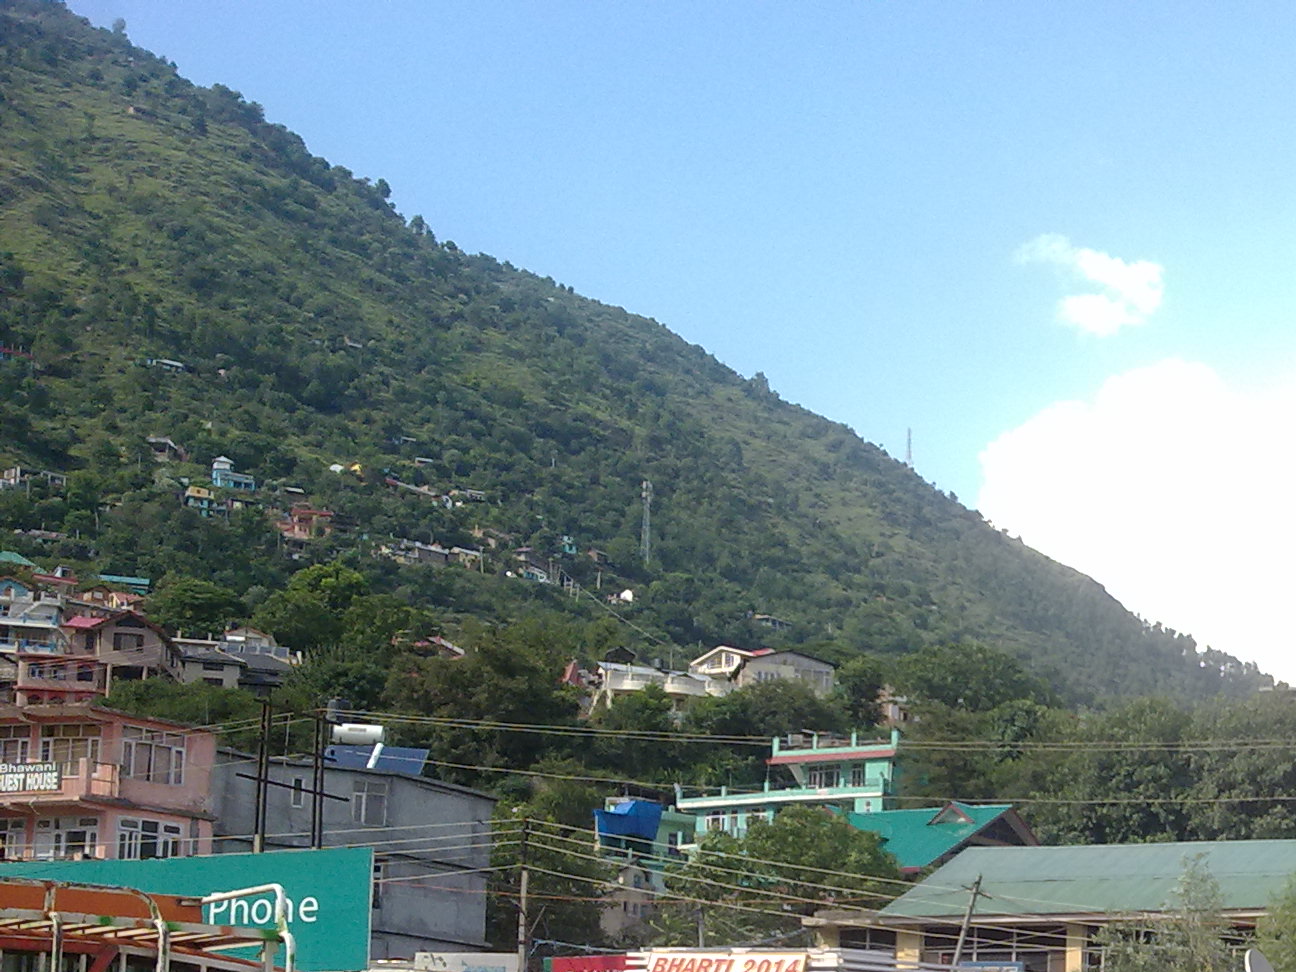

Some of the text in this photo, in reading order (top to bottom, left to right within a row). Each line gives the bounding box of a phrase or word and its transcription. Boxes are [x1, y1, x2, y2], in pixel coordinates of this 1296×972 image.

[0, 772, 58, 791] UEST HOUSE
[208, 892, 319, 925] Phone
